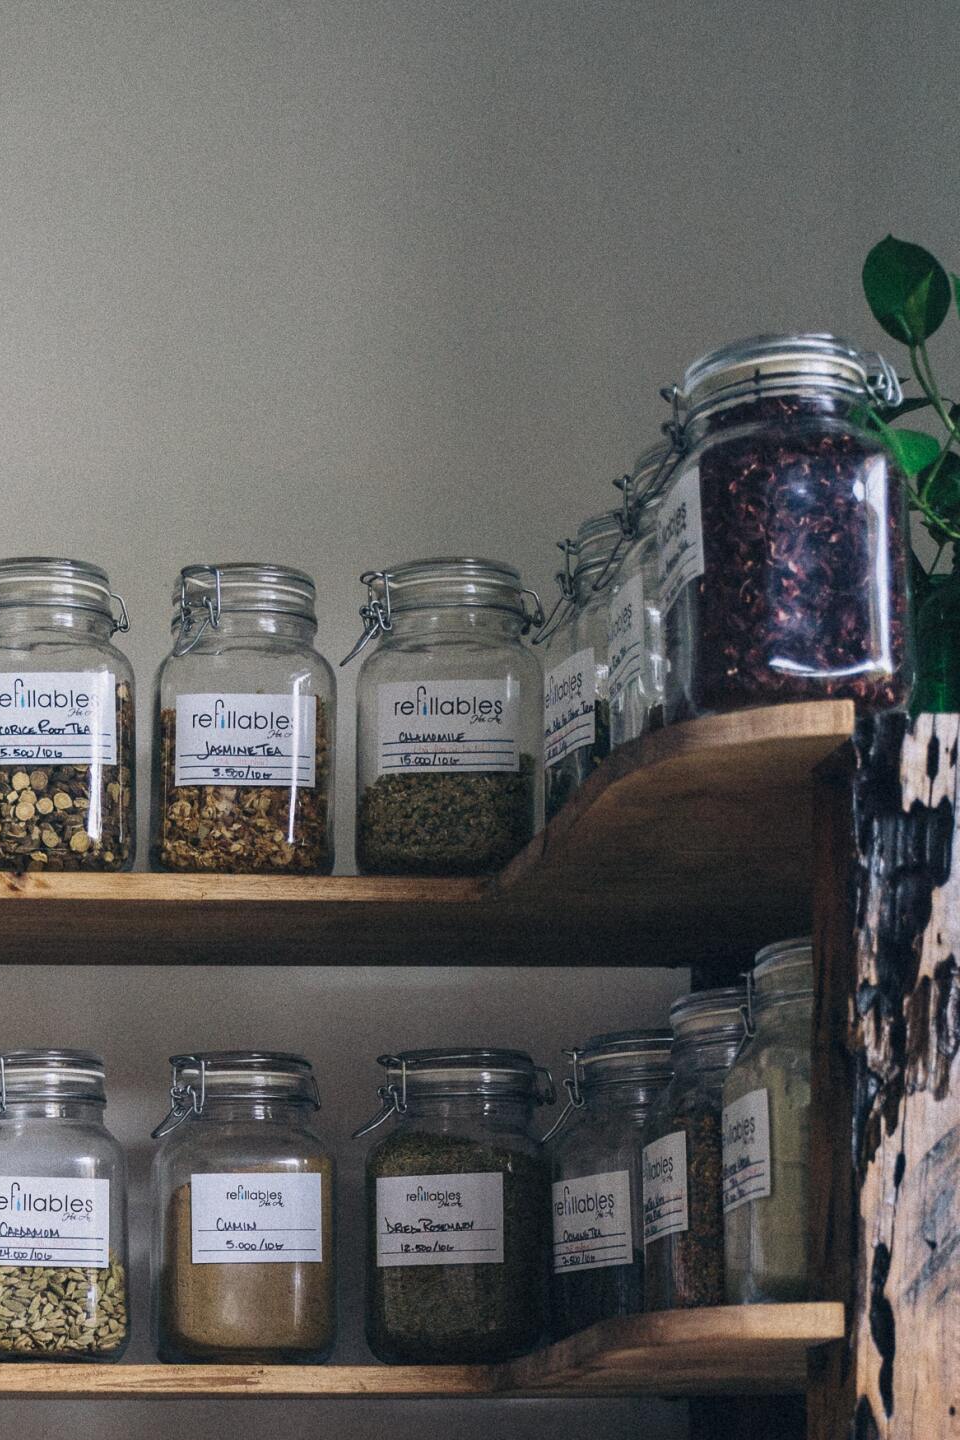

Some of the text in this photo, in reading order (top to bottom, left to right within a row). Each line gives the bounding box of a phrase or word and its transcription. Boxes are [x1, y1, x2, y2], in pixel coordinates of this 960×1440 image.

[395, 686, 502, 715] refillables
[192, 699, 293, 729] refillable
[38, 720, 65, 734] ROOT
[66, 723, 90, 734] TEA
[399, 732, 464, 743] CHAMOMILE
[197, 742, 283, 760] JASMINE TEA
[227, 1185, 282, 1200] refillables
[406, 1186, 460, 1202] refillables
[554, 1186, 614, 1216] refillables
[0, 1222, 59, 1238] CARDAMOM
[217, 1218, 256, 1231] CUMIN
